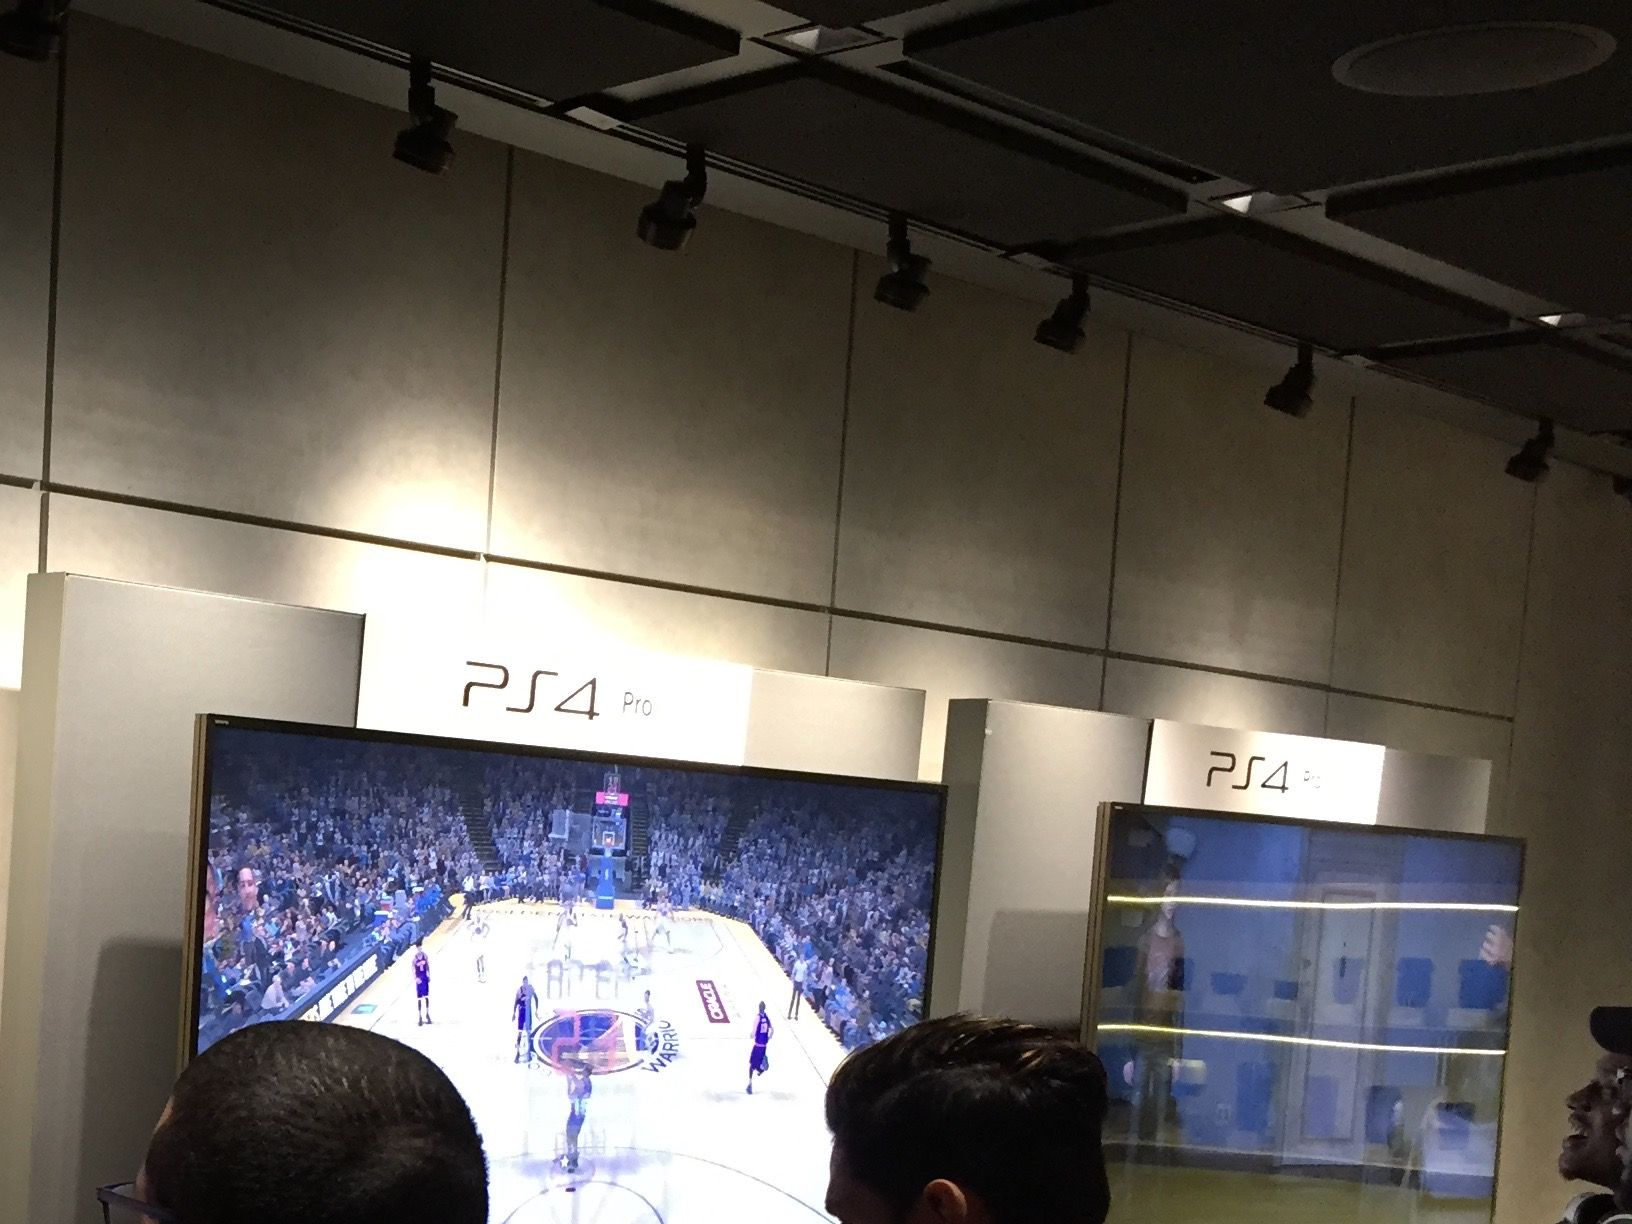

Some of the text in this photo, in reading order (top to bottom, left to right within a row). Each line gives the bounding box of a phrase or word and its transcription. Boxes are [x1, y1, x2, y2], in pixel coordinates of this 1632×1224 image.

[463, 661, 653, 720] PS4 Pro
[1206, 750, 1289, 793] PS4
